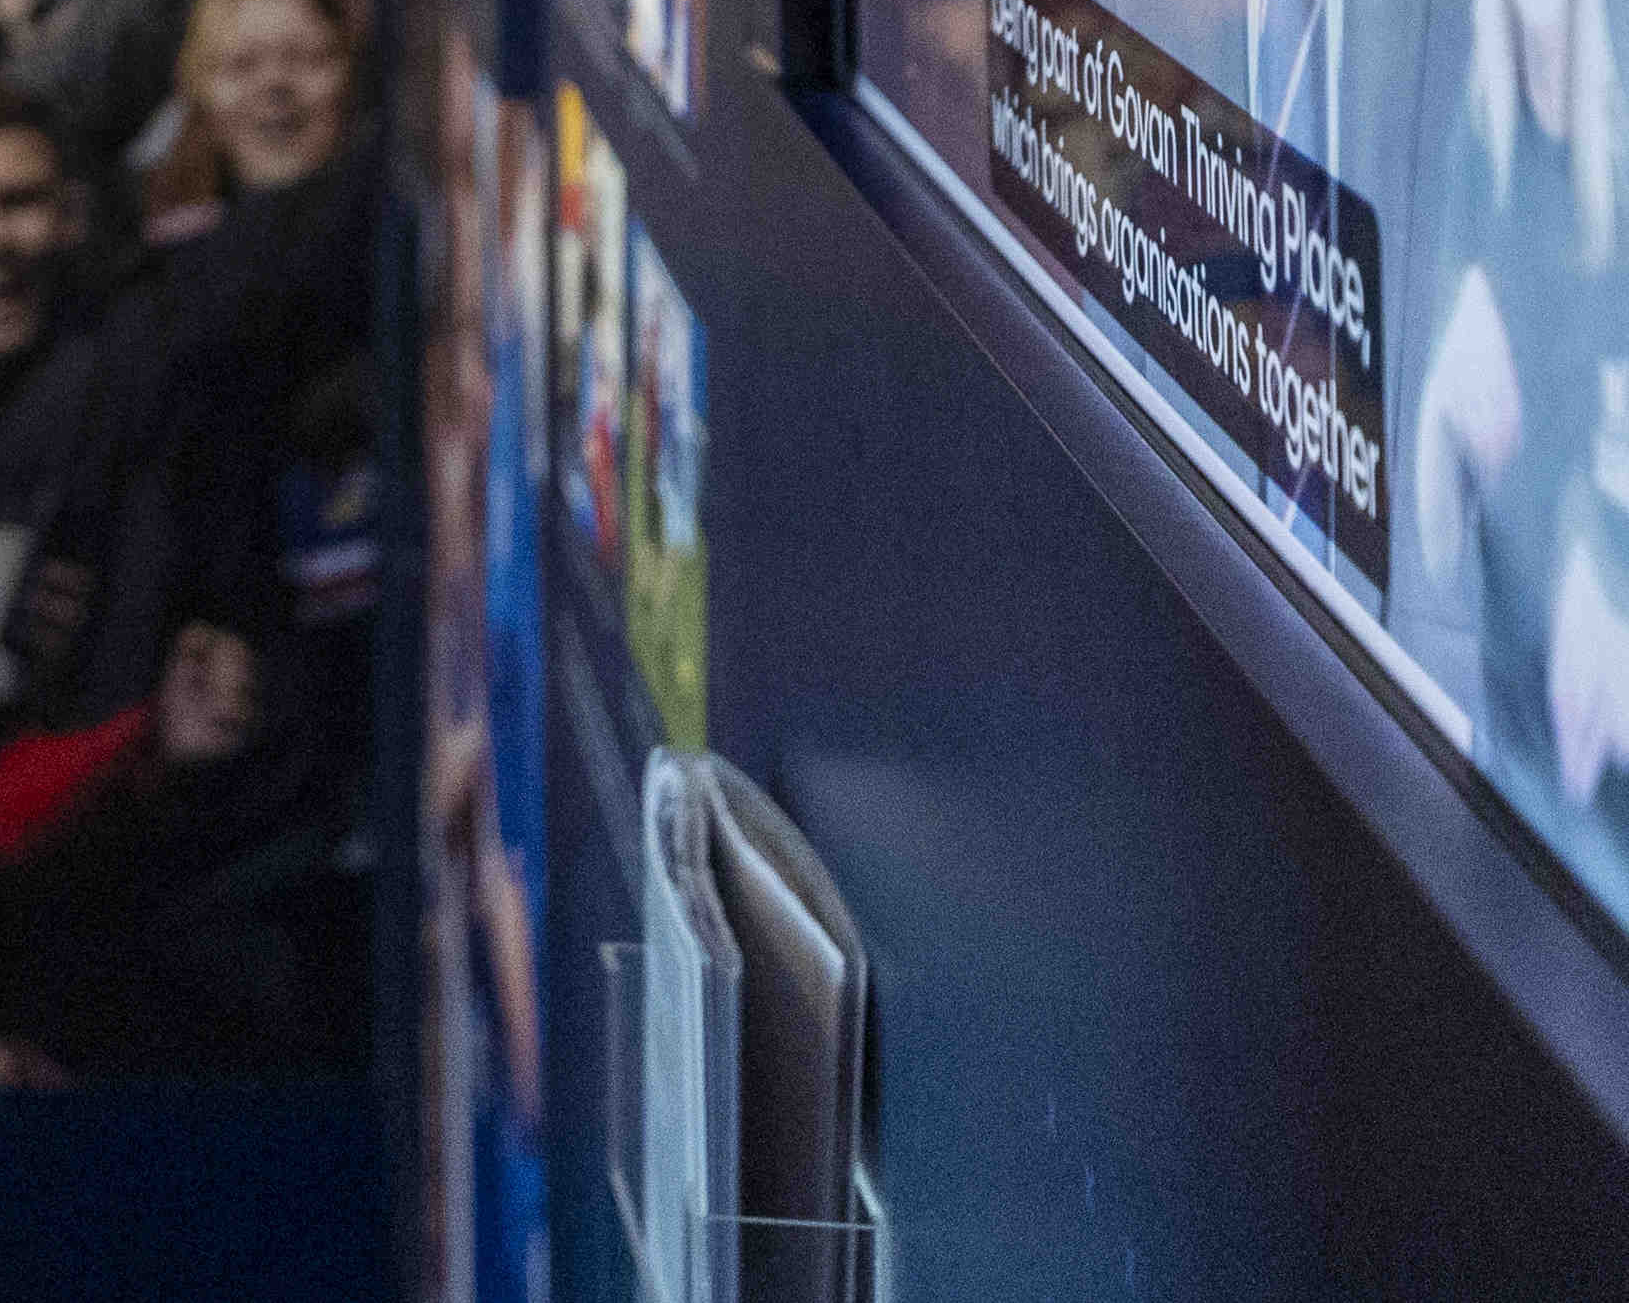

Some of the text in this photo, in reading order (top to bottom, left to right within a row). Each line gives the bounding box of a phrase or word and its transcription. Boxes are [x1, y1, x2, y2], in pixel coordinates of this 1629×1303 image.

[991, 85, 1381, 520] which brings organisations together
[1041, 15, 1081, 104] part
[1083, 37, 1104, 122] of
[1107, 49, 1178, 187] Govan
[1180, 104, 1277, 293] Thriving
[1283, 181, 1371, 370] Place,
